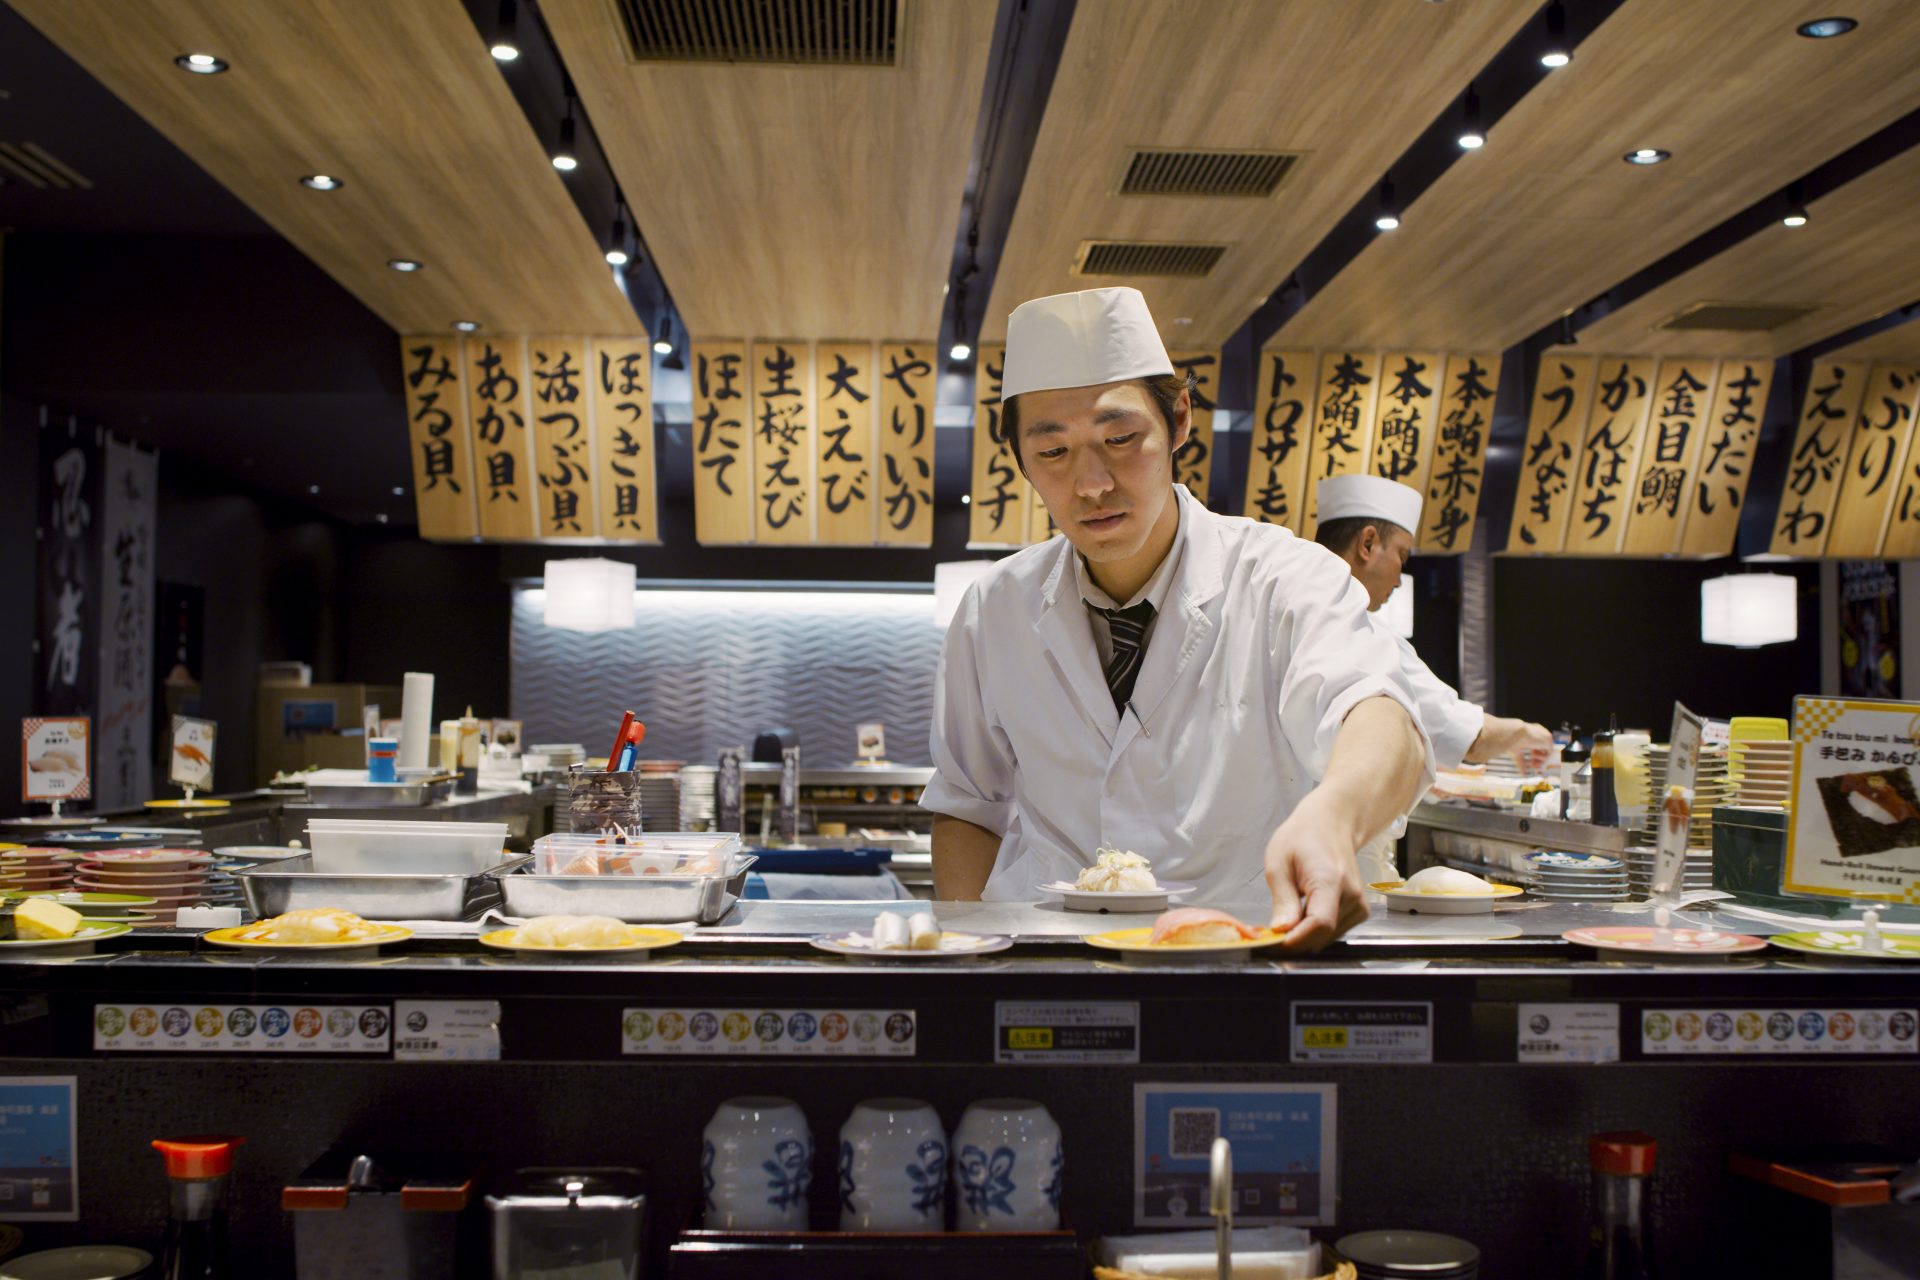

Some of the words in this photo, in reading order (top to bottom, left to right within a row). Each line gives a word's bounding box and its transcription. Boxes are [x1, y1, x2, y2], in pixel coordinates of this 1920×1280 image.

[410, 344, 461, 493] みる貝
[475, 343, 525, 503] あか貝
[534, 351, 589, 532] 活つぶ貝
[600, 351, 644, 530] ほっき貝
[697, 353, 743, 496] ほたて
[756, 347, 806, 529] 生桜えび
[822, 353, 870, 514] 大えび
[884, 348, 932, 530] やりいか
[1254, 356, 1304, 522] トロサーモ
[1311, 354, 1372, 519] 本鮪大ト
[1378, 357, 1431, 481] 本鮪中
[1425, 359, 1495, 550] 本鮪赤身
[1520, 364, 1576, 544] うなぎ
[1636, 369, 1707, 518] 金目鯛
[1698, 366, 1760, 515] まだい
[1779, 366, 1845, 543] えんがわ
[1859, 371, 1920, 496] ぶり
